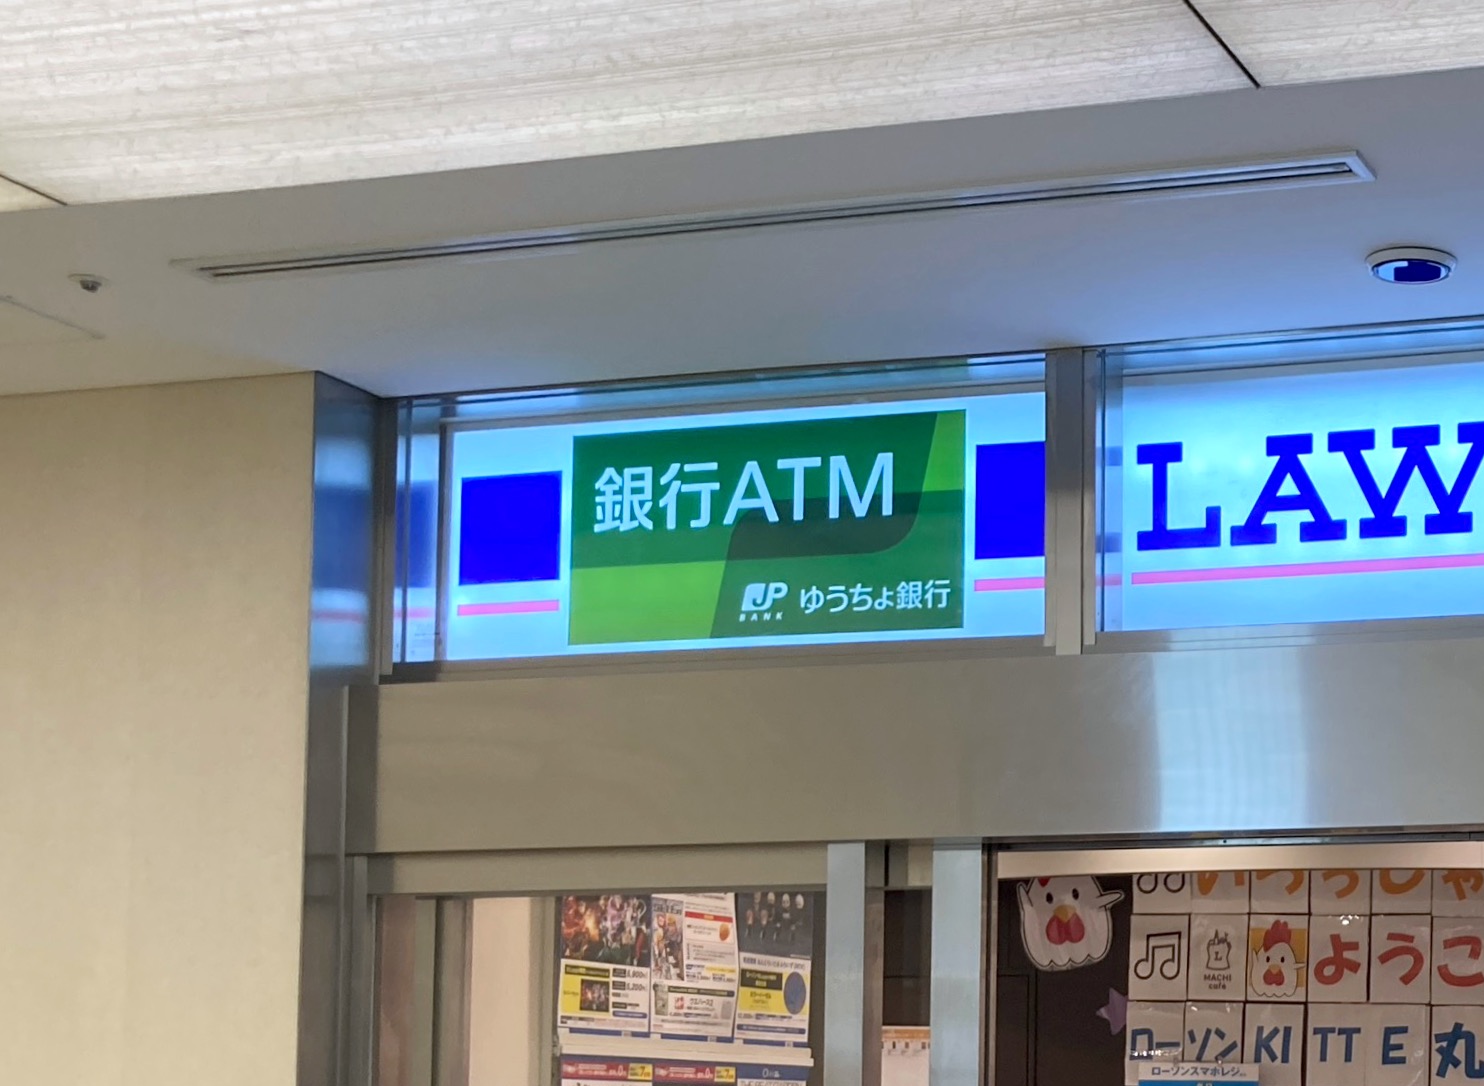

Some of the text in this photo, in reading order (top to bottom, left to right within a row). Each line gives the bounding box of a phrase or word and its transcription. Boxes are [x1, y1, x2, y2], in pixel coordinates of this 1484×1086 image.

[593, 451, 895, 535] 銀行ATM
[799, 579, 952, 615] ゆうちょ銀行
[739, 611, 784, 622] BANK
[1203, 973, 1232, 982] MACHI
[1151, 1065, 1240, 1078] ローソンスマホレジ
